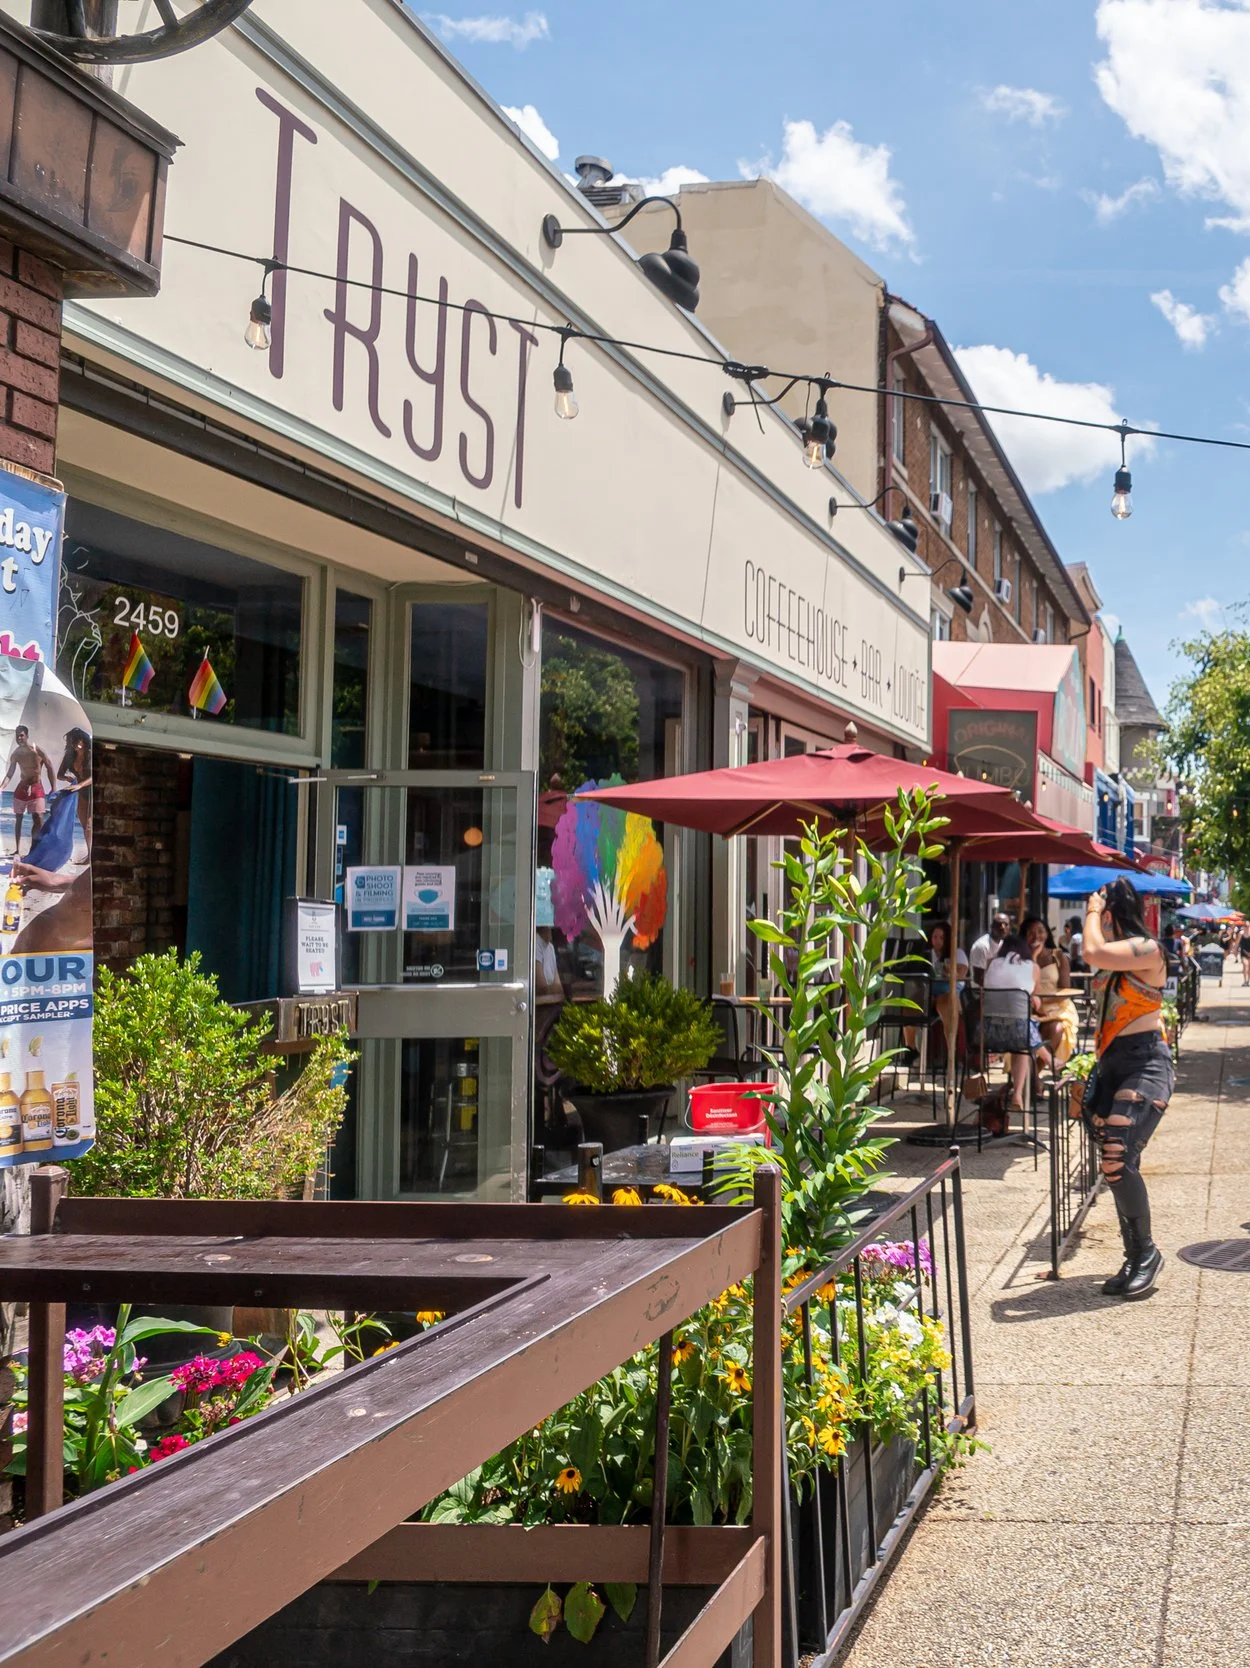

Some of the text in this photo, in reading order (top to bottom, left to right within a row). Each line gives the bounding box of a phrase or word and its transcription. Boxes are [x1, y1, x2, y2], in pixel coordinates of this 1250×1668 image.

[255, 87, 540, 508] TRYST
[114, 596, 179, 639] 2459
[745, 560, 849, 688] COFFEEHOUSE
[861, 639, 884, 709] BAR
[11, 983, 87, 998] 5PM-8PM
[1, 999, 89, 1015] PRICE APPS
[672, 1151, 699, 1159] Reliance
